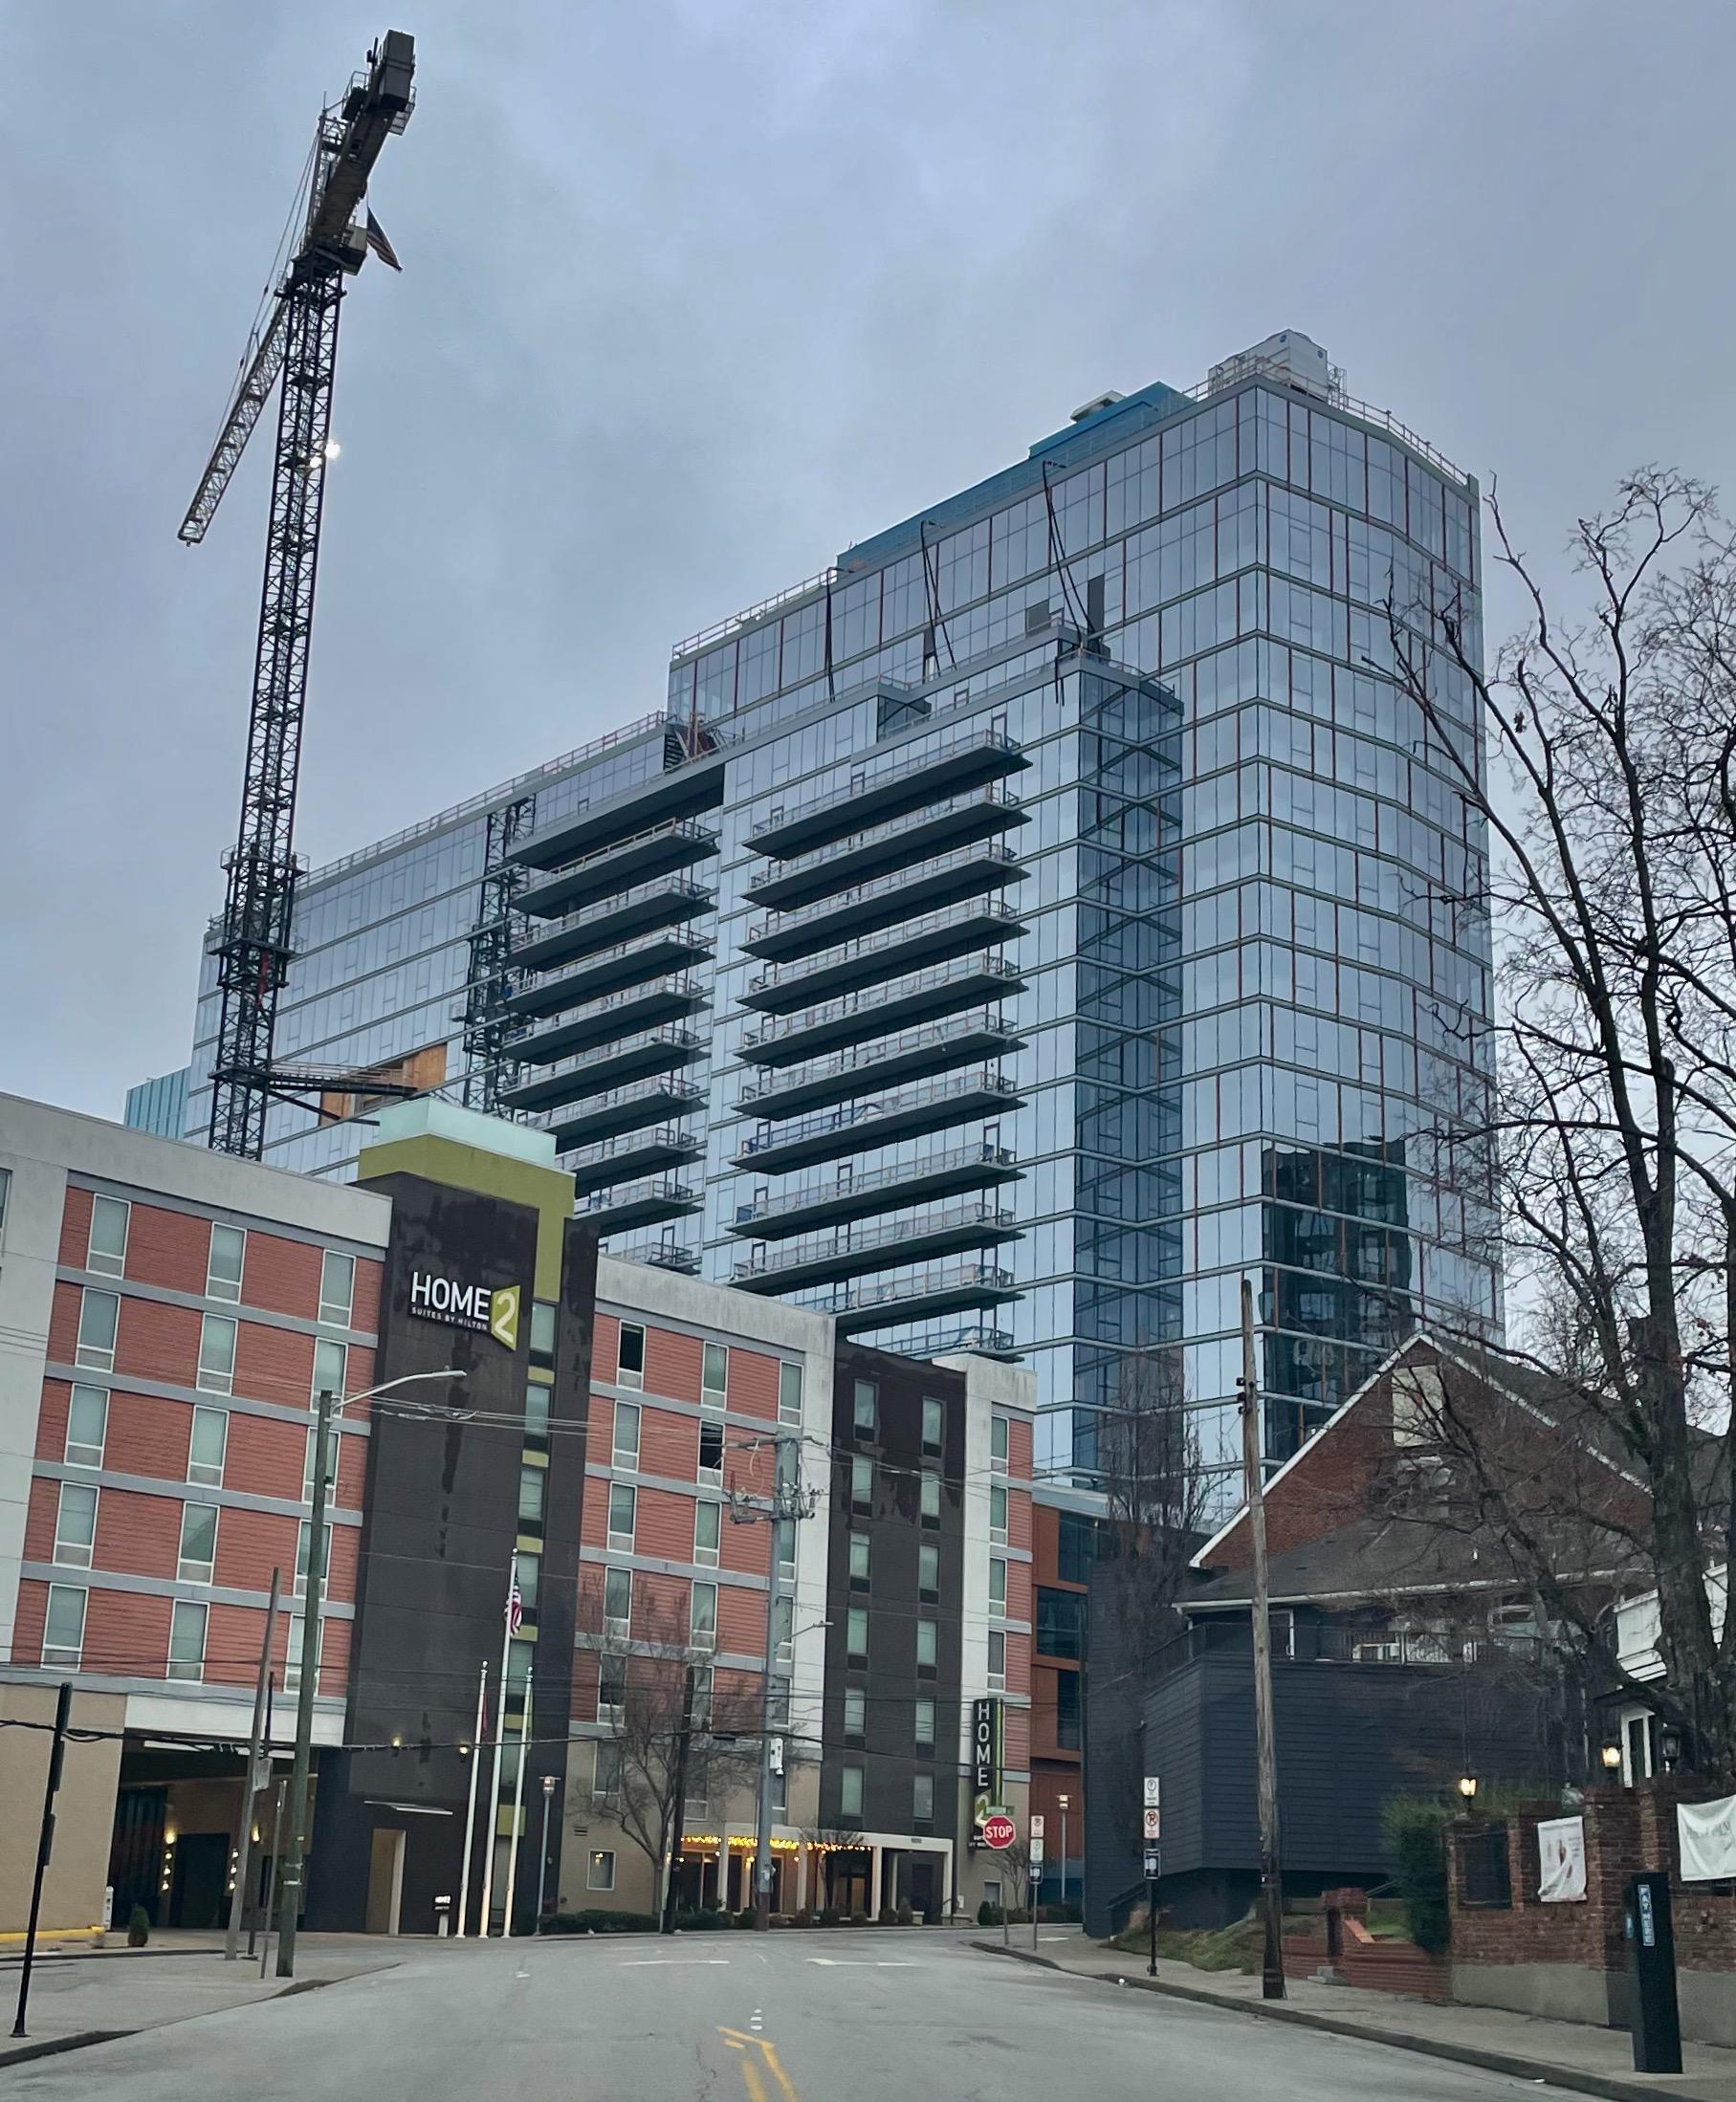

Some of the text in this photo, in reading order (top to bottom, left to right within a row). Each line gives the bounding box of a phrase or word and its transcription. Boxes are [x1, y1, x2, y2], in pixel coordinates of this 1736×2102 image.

[411, 1306, 488, 1331] SUITES BY HILTON
[985, 1825, 1014, 1839] STOP
